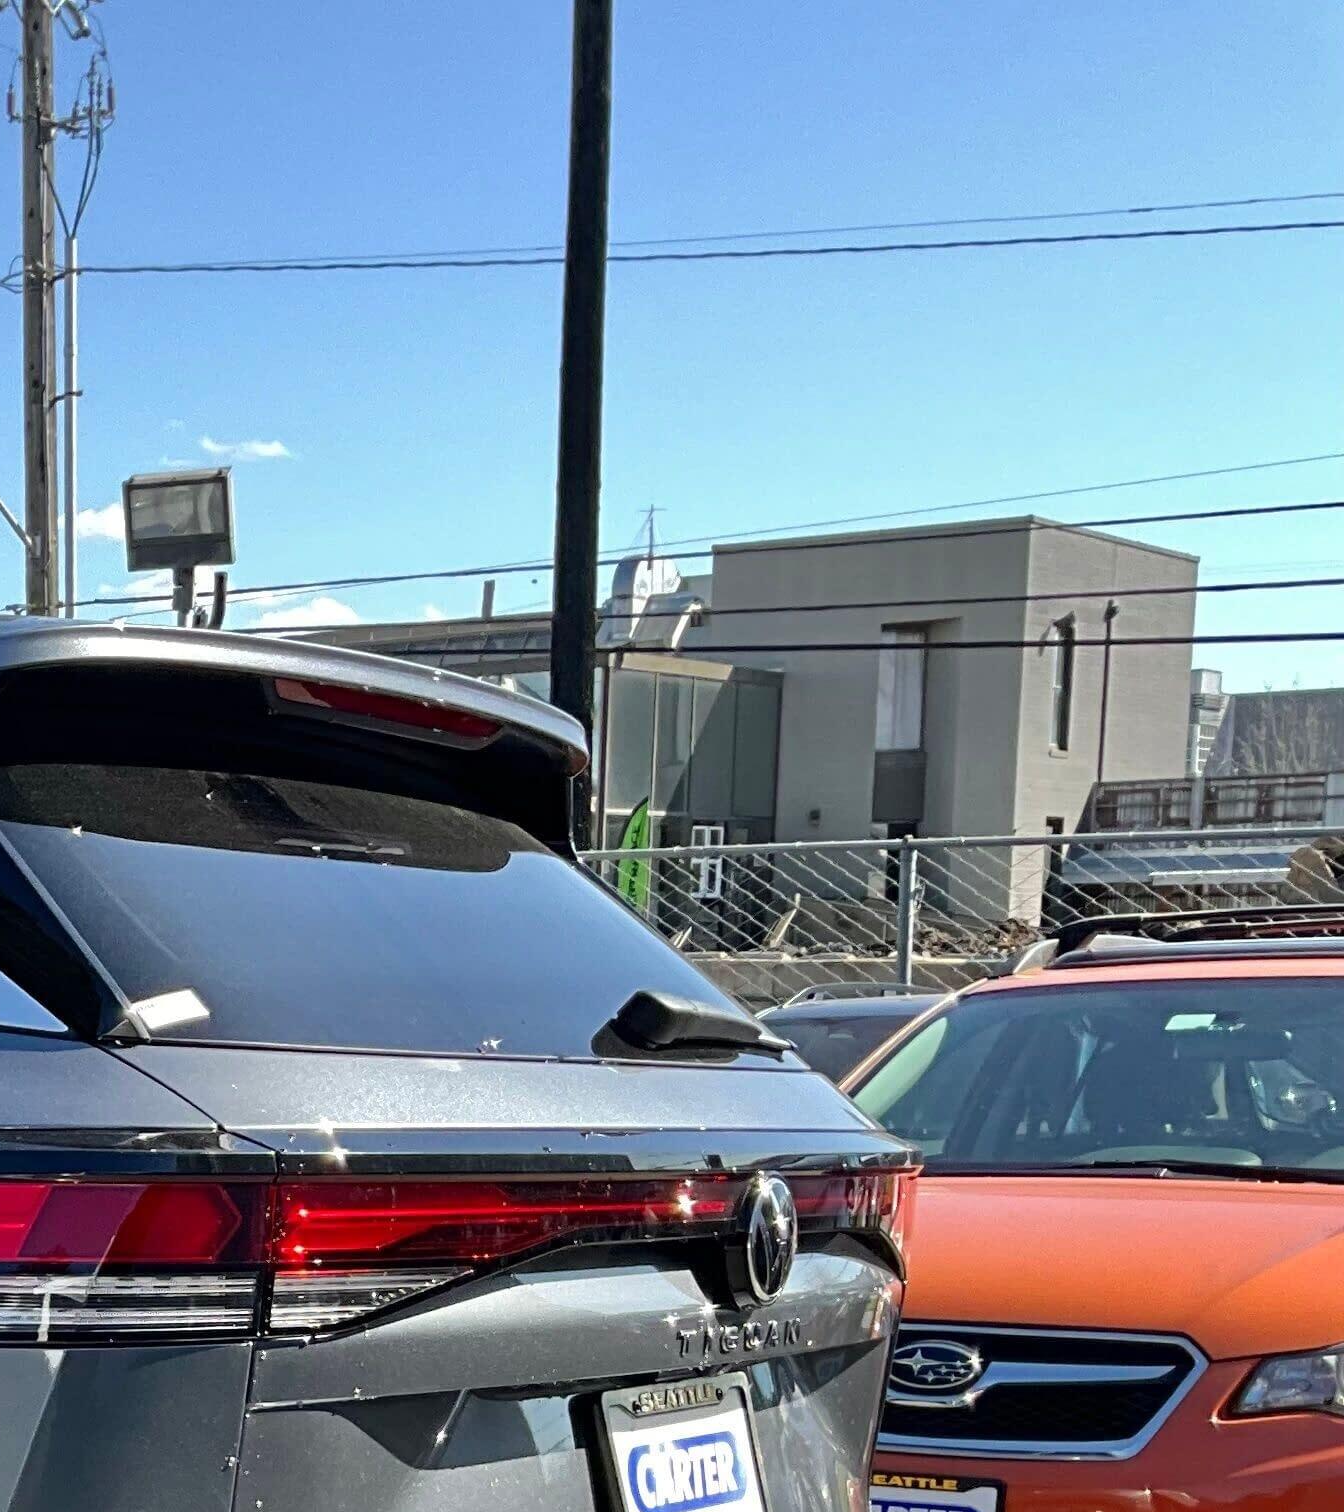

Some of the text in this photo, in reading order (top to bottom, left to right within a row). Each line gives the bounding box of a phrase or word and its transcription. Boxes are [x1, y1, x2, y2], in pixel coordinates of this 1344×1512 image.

[676, 1318, 801, 1358] TIGUAN
[638, 1382, 717, 1413] SEATTLE
[636, 1441, 739, 1509] CARTER
[872, 1474, 959, 1490] EATTLE
